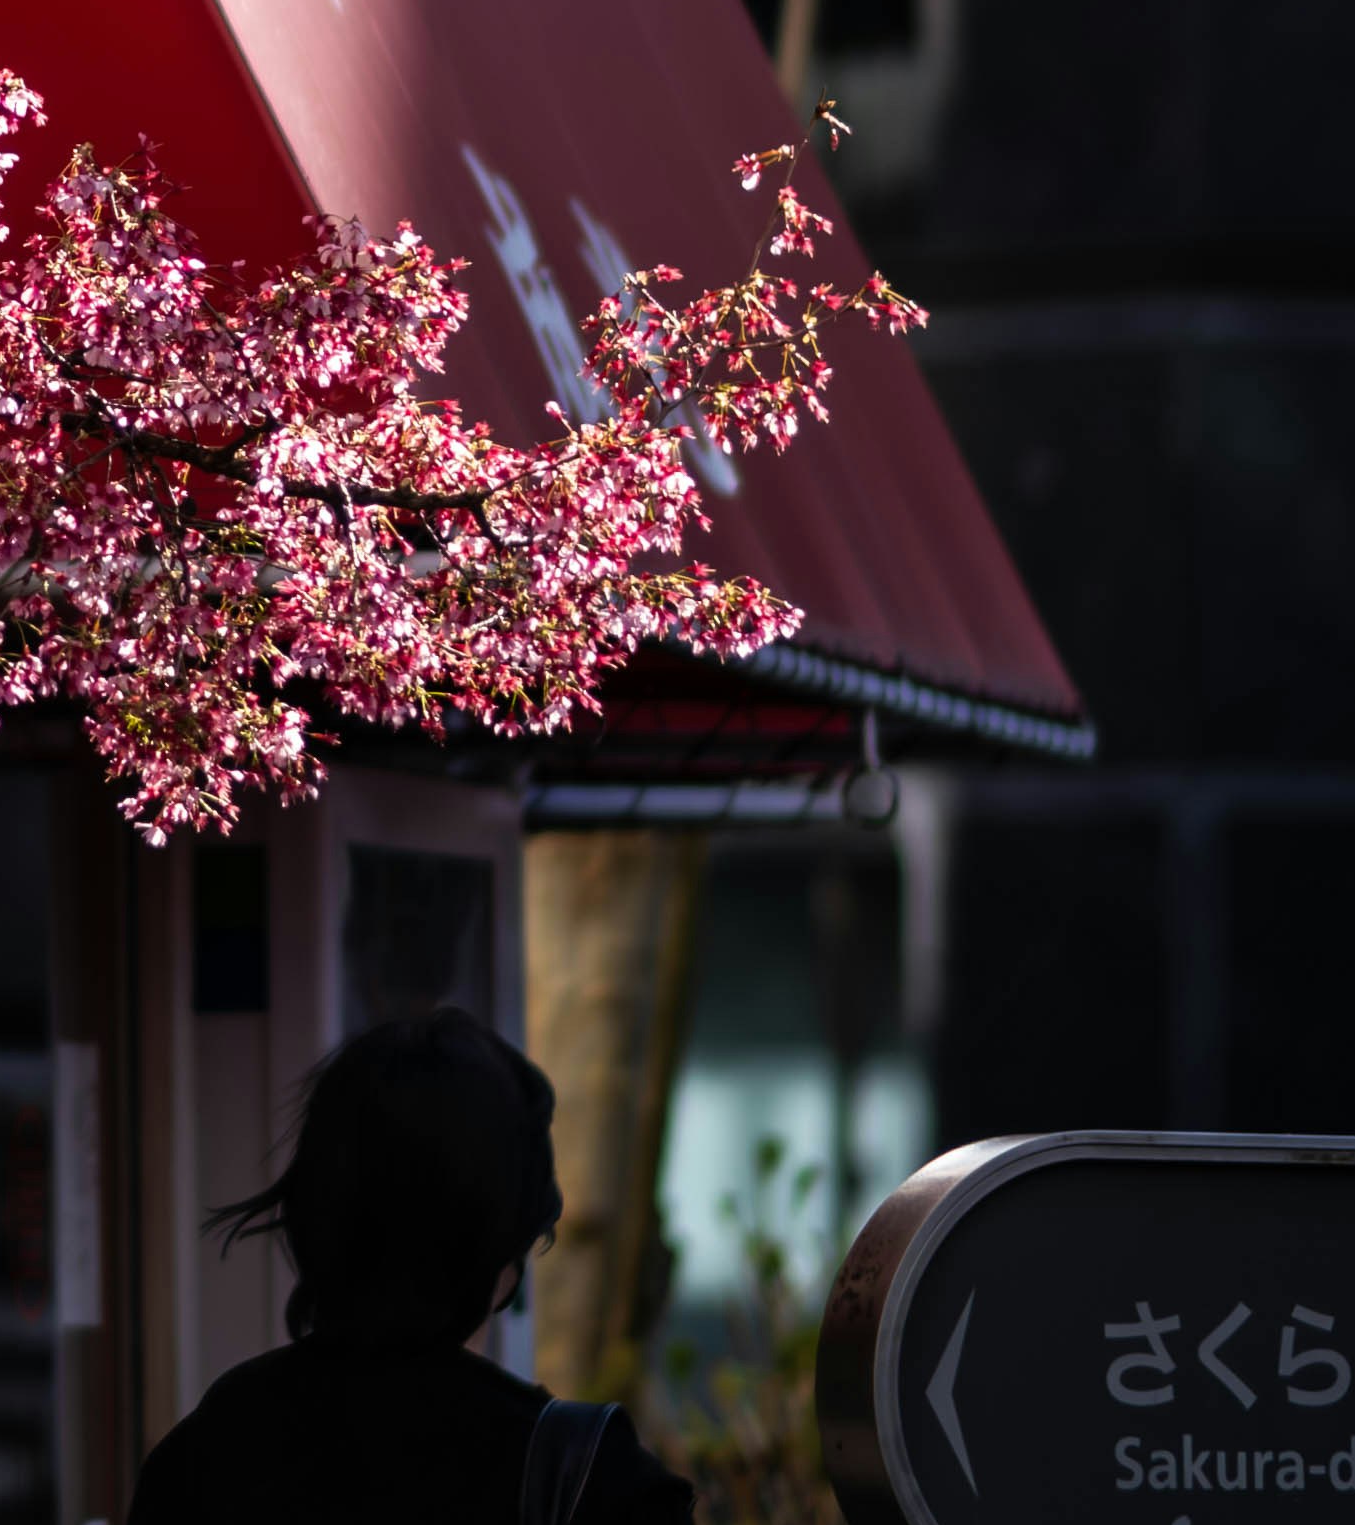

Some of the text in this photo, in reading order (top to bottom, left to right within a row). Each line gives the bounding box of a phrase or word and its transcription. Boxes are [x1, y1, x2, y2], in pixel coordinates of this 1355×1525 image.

[1102, 1299, 1353, 1411] さくら
[1113, 1433, 1355, 1493] Sakura-d
